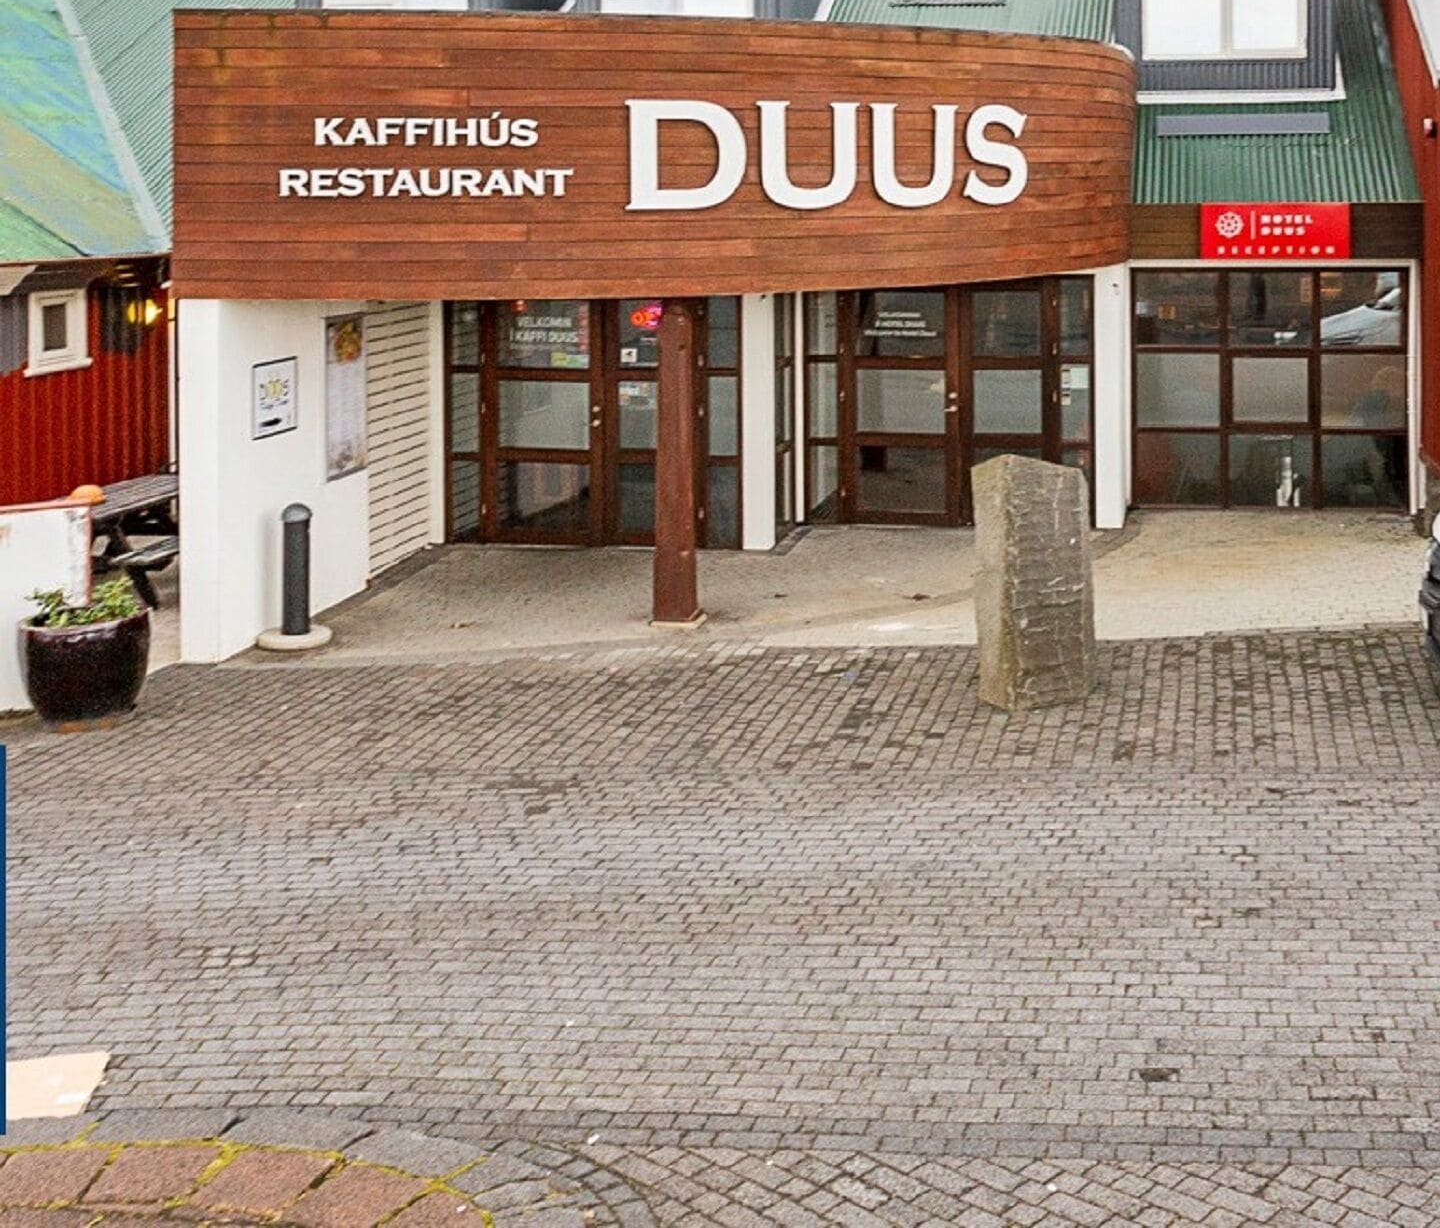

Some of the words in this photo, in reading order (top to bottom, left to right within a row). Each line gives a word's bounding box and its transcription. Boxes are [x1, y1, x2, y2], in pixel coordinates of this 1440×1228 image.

[313, 110, 539, 148] KAFFIHÚS
[624, 98, 1029, 213] DUUS
[278, 167, 574, 200] RESTAURANT
[1260, 214, 1314, 225] HOTEL
[1260, 225, 1306, 237] DUUS
[1216, 245, 1336, 256] RECEPTION
